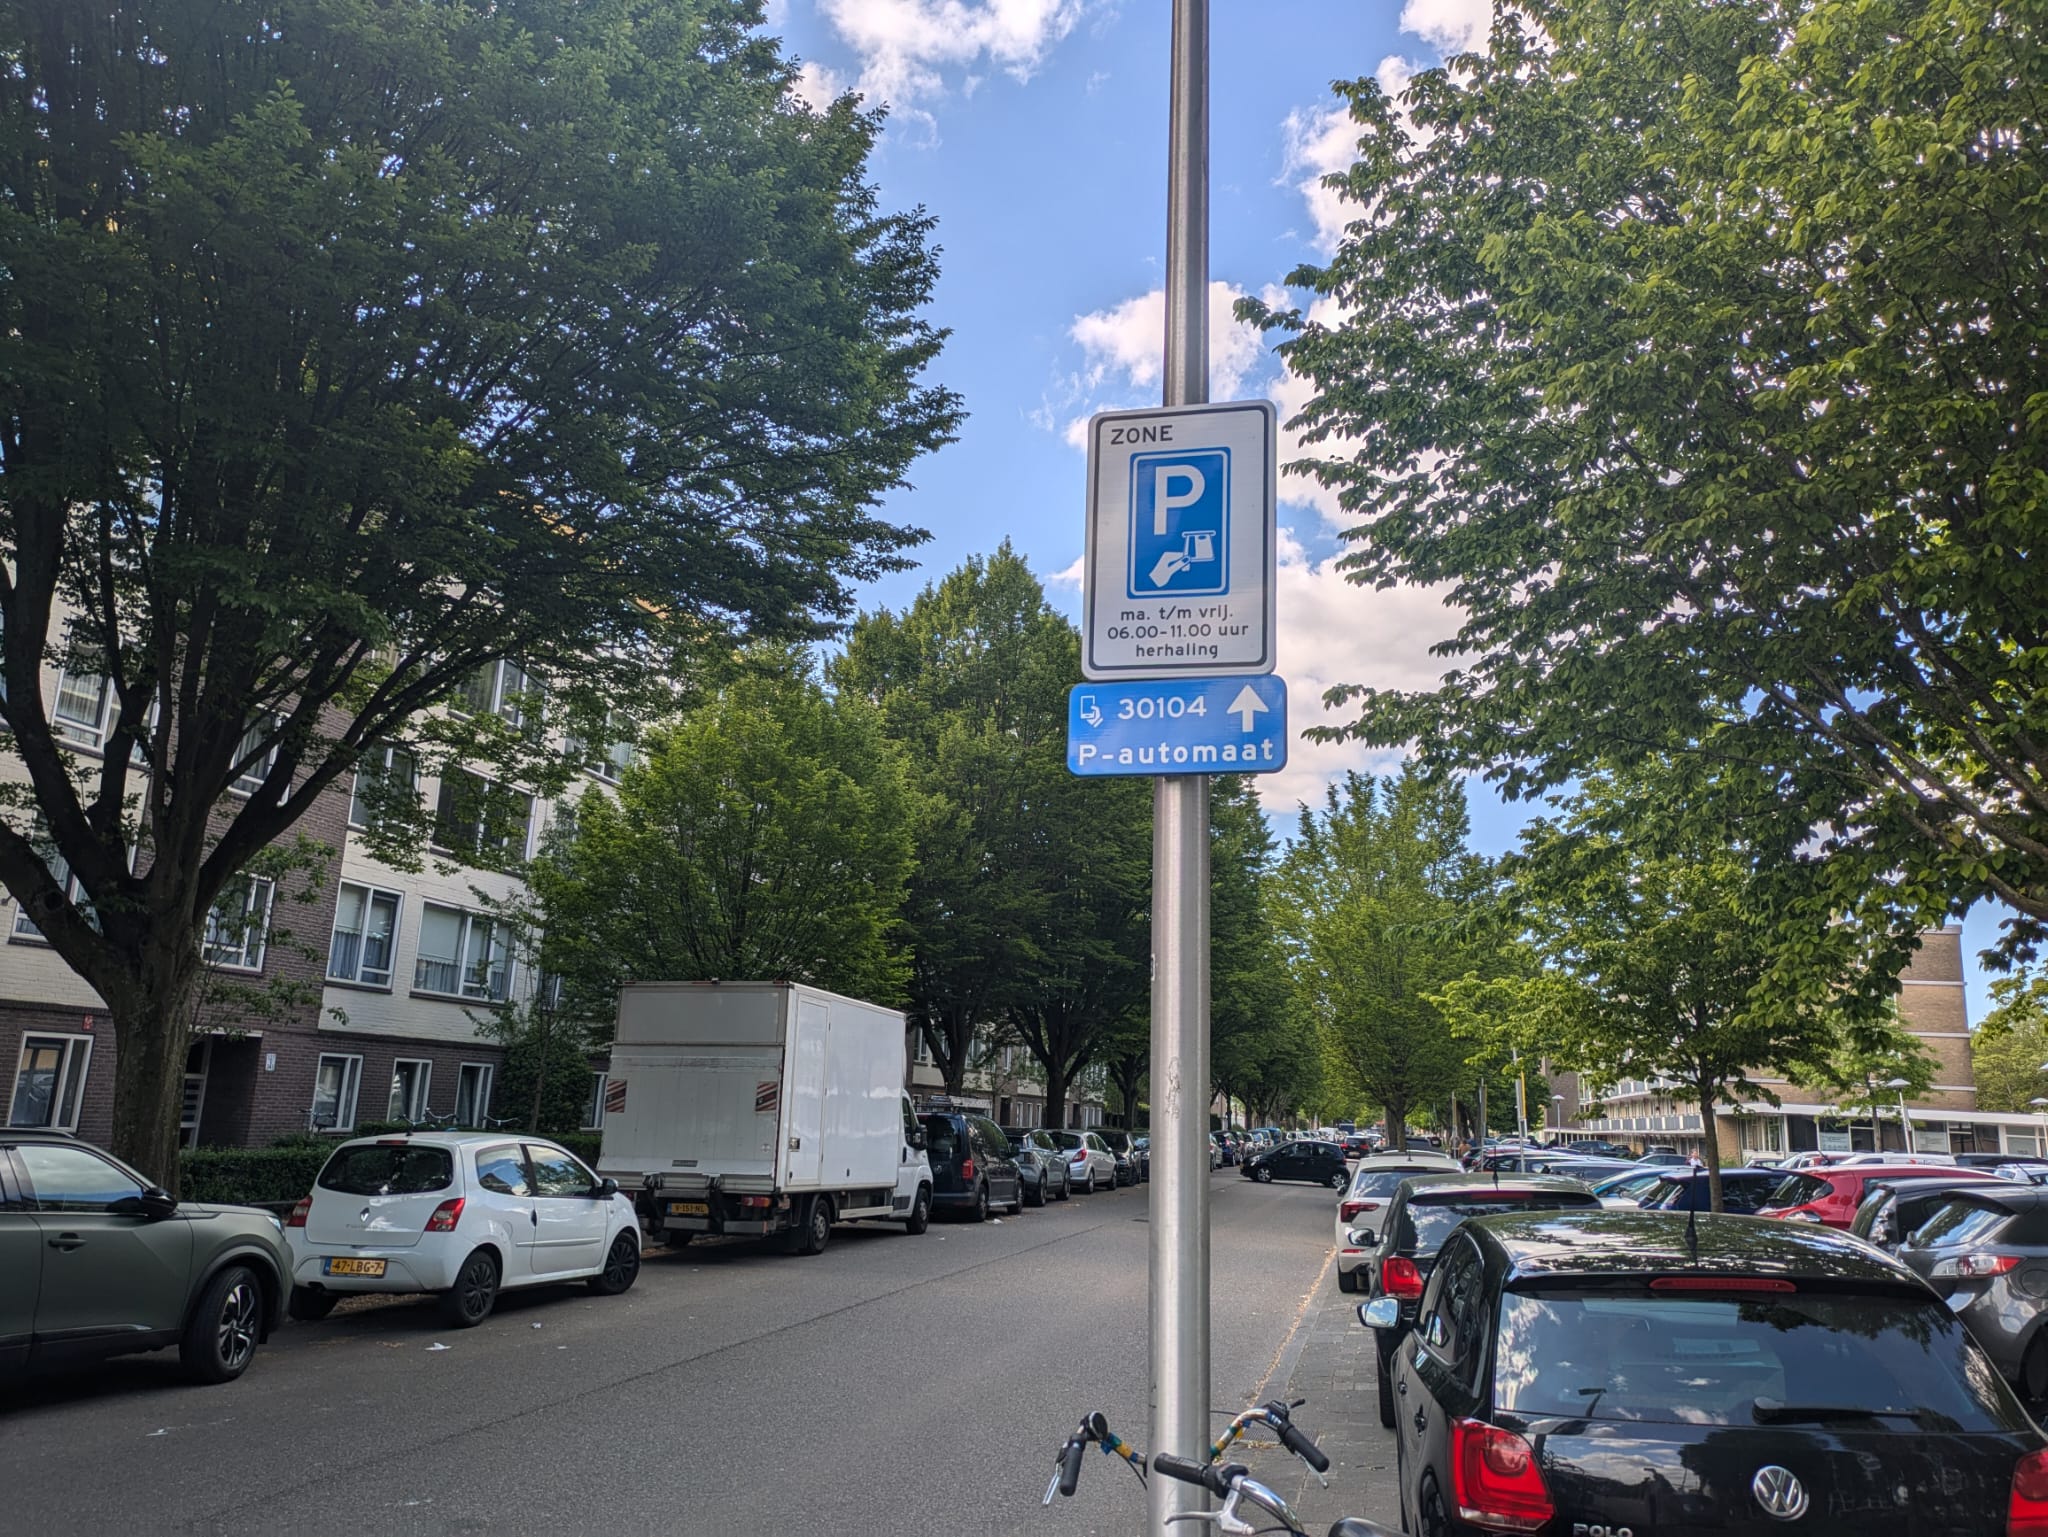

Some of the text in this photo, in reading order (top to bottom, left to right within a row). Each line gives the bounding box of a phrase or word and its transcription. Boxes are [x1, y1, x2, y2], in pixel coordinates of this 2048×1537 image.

[1111, 425, 1173, 445] ZONE
[1154, 465, 1206, 536] P
[1120, 605, 1233, 621] ma. t/m vrij.
[1107, 624, 1249, 640] 06.00-11.00 uur
[1135, 643, 1219, 659] herhaling
[1118, 696, 1207, 720] 30104
[1078, 739, 1274, 766] P-automaat
[1573, 1523, 1633, 1537] POLO
